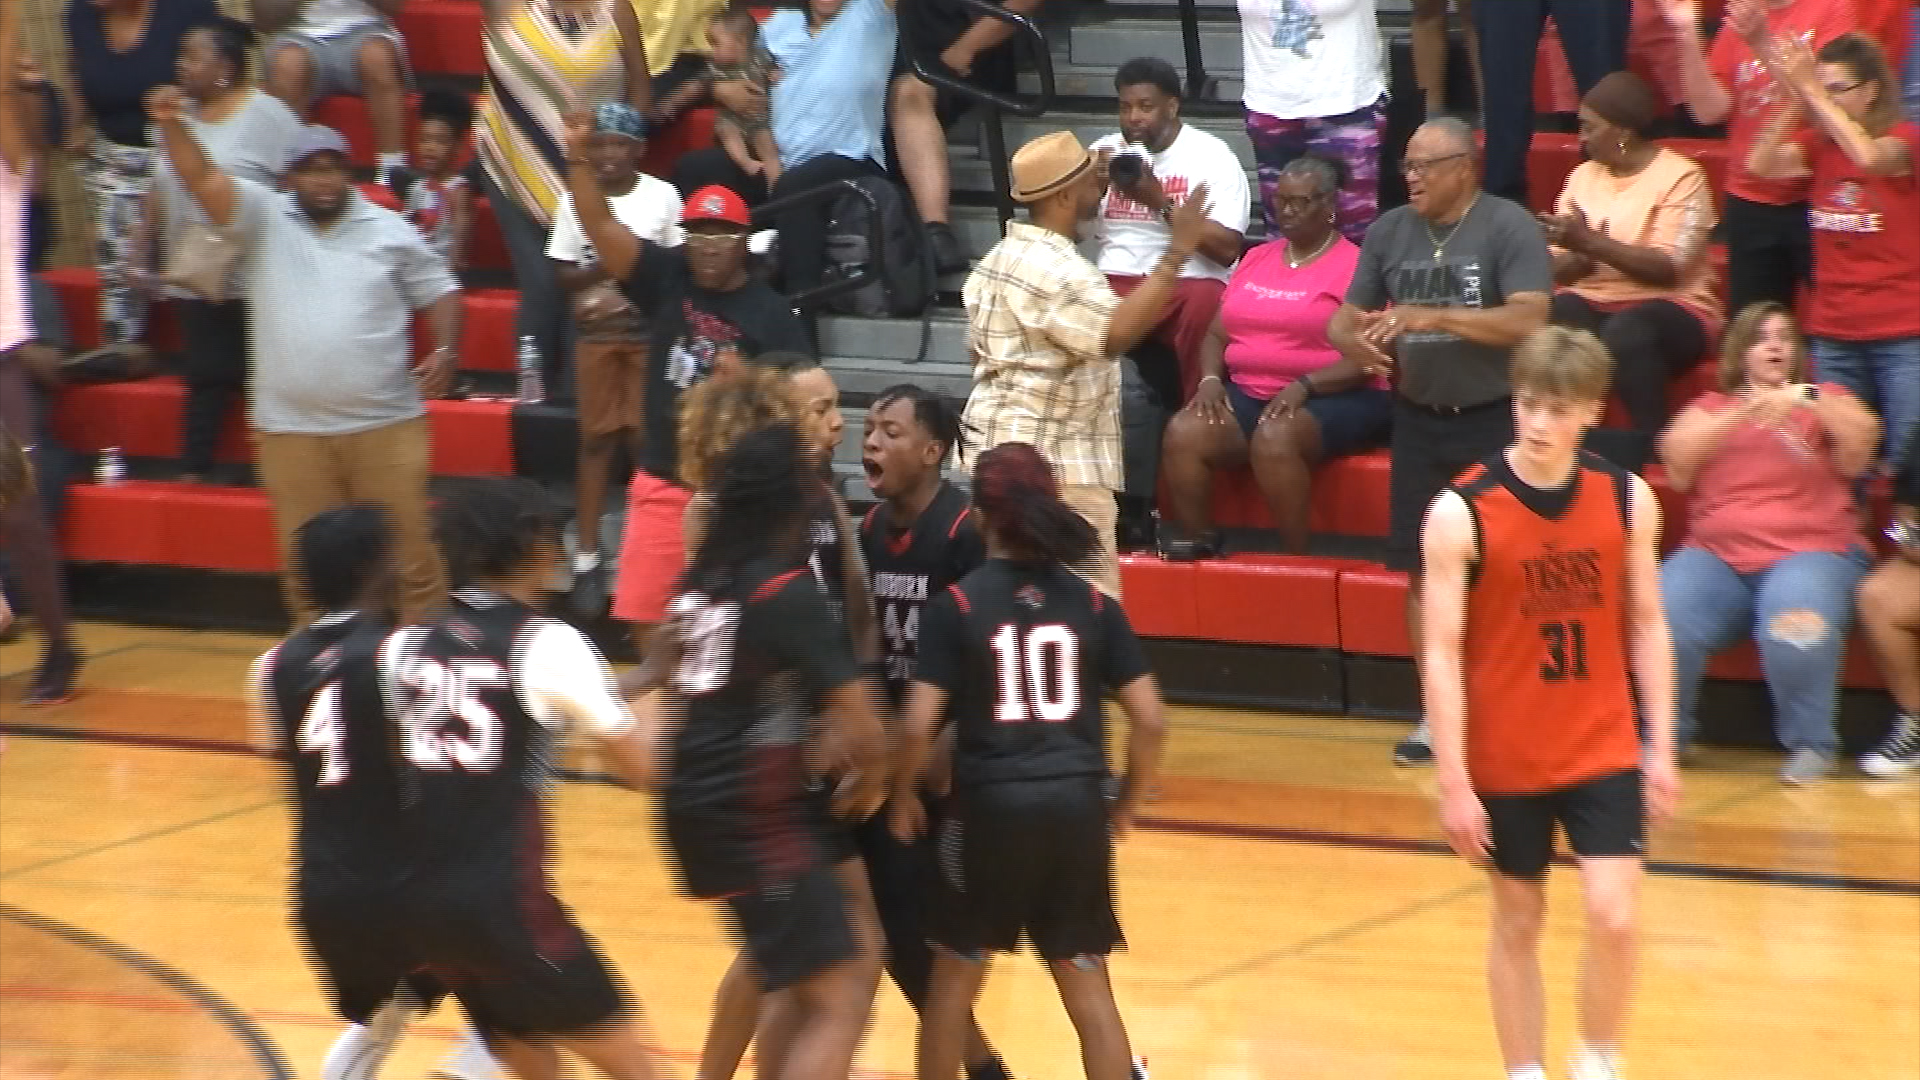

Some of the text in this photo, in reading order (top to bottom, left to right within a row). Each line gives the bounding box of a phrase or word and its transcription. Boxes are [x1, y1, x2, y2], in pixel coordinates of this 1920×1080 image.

[989, 623, 1082, 721] 10
[1538, 621, 1589, 684] 31
[295, 680, 351, 786] 4
[399, 657, 509, 773] 25
